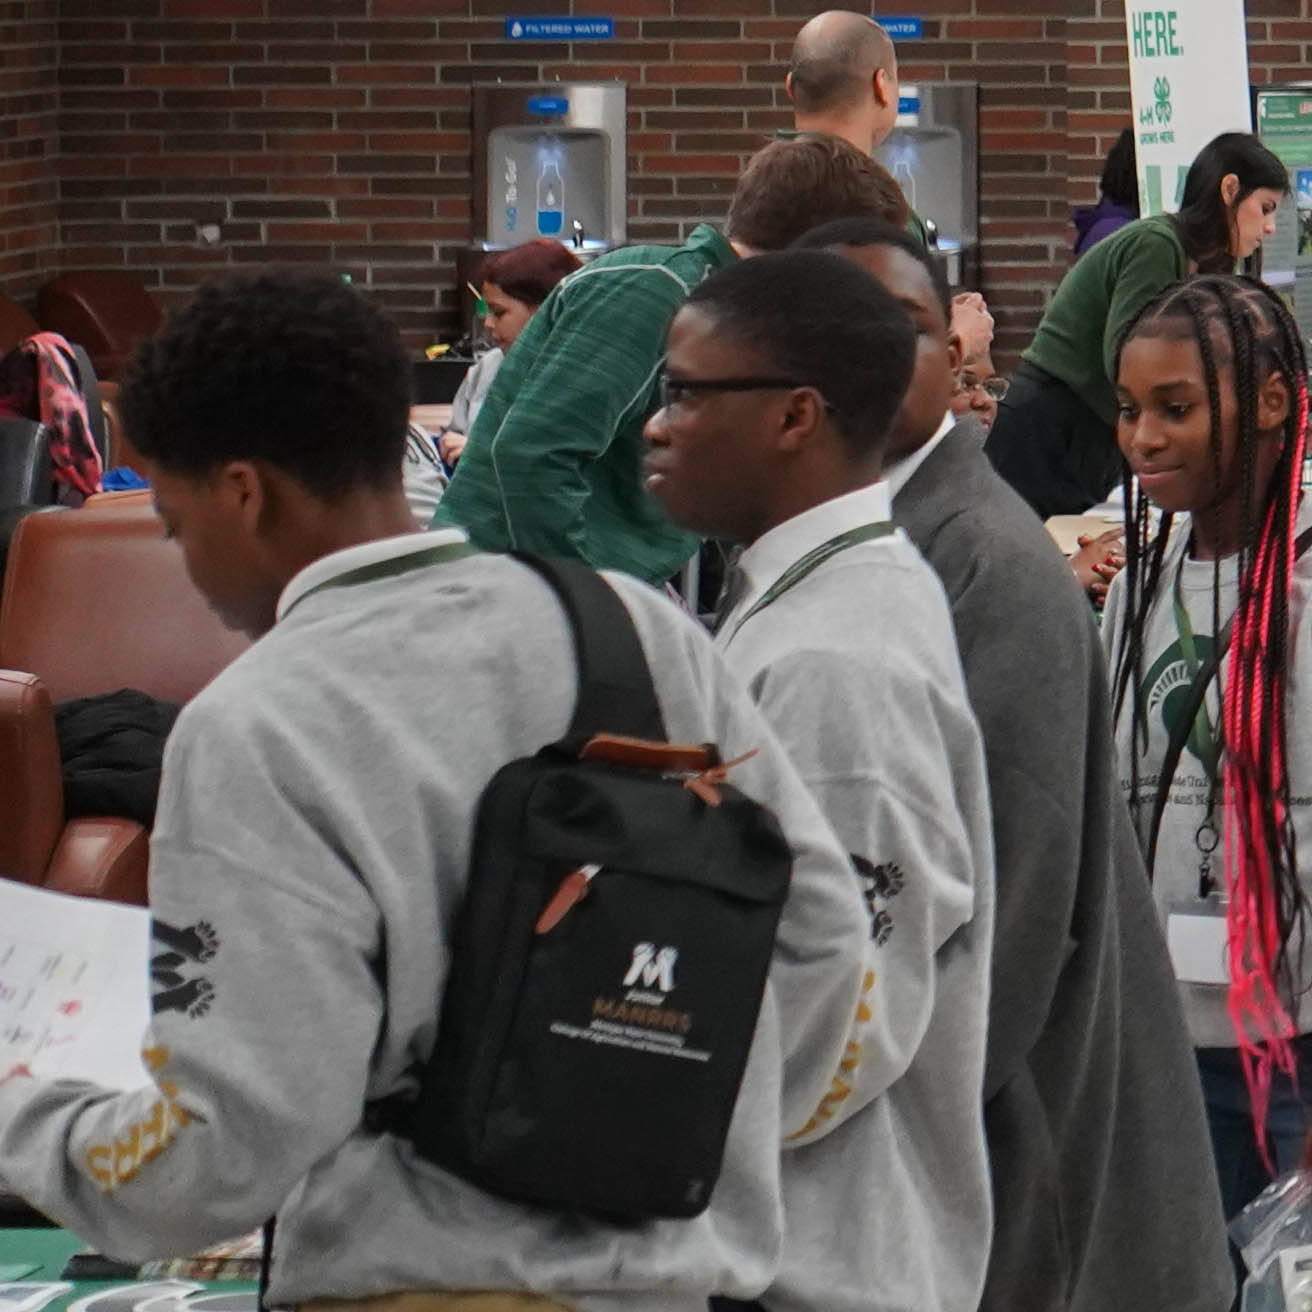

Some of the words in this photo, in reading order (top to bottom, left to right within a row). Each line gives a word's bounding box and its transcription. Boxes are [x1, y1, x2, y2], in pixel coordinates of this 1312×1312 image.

[525, 24, 573, 35] FILTERED
[574, 24, 609, 35] WATER
[1132, 11, 1184, 58] HERE.
